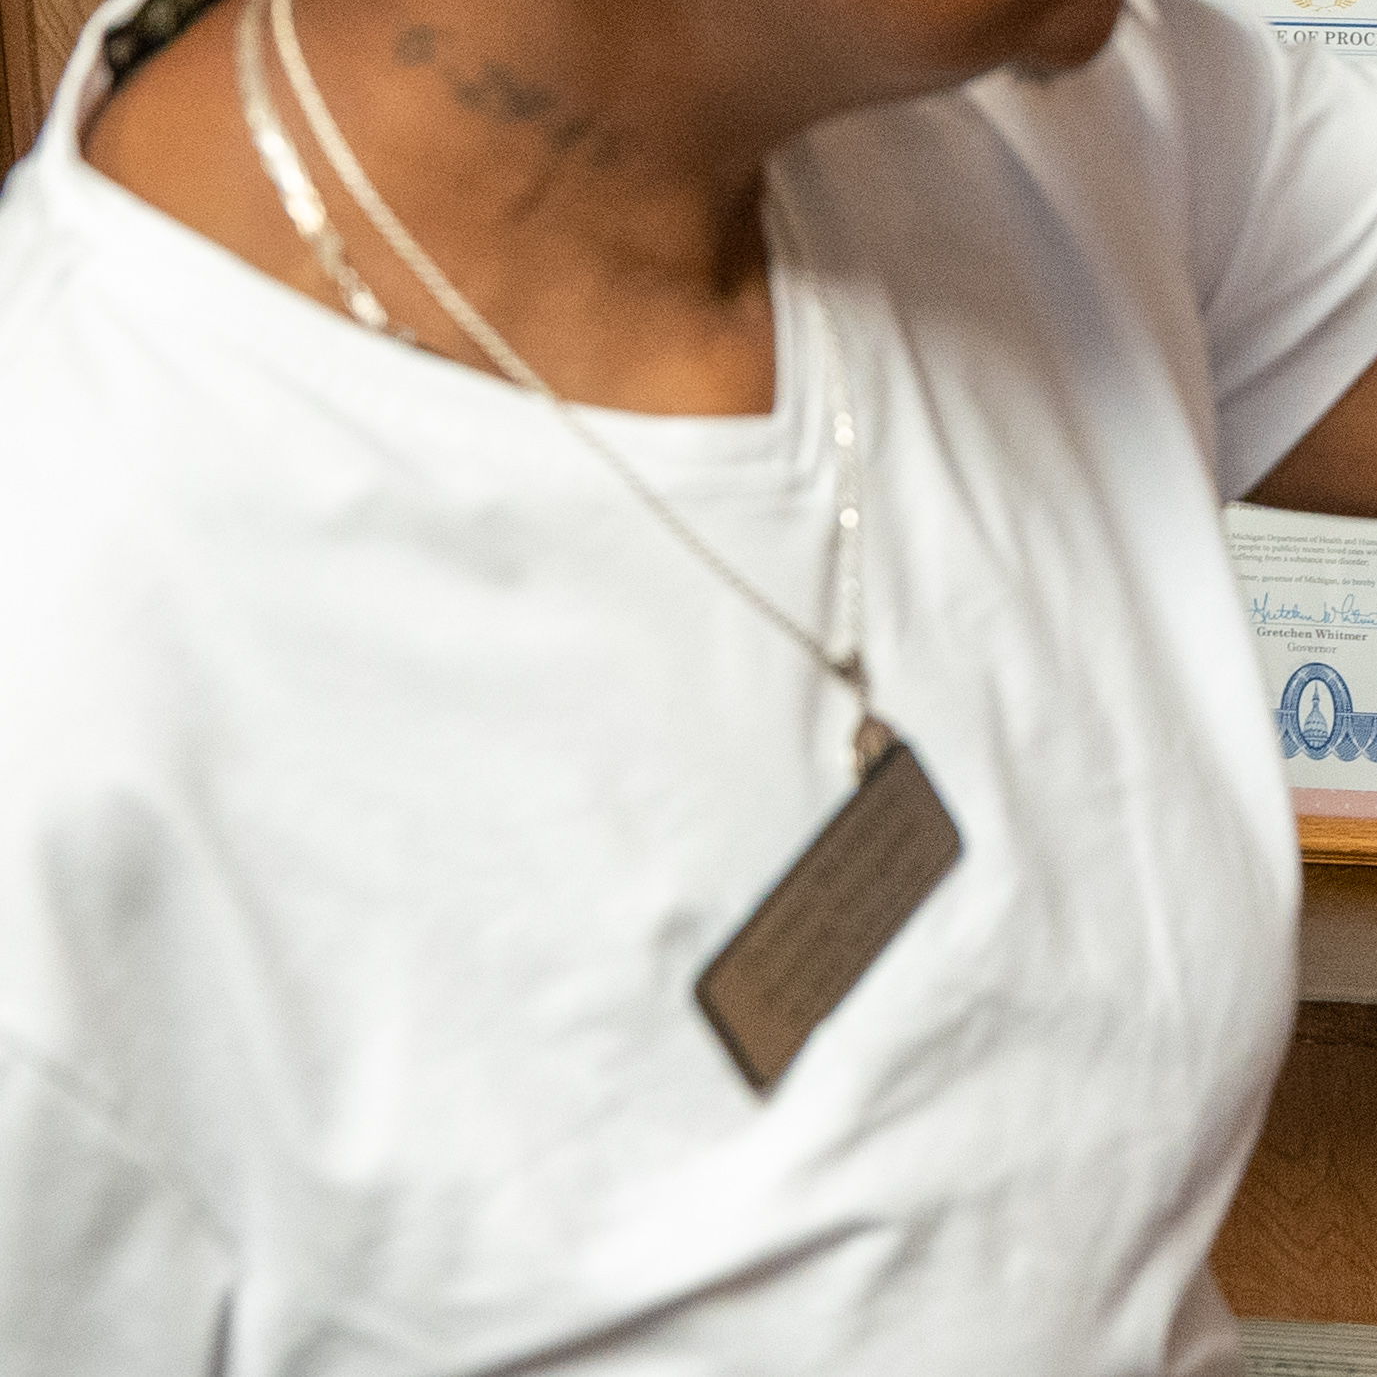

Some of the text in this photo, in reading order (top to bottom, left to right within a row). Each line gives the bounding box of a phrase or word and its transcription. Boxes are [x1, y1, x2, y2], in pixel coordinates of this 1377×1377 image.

[1293, 30, 1320, 46] OF
[1257, 626, 1368, 641] Gretchen Whitmer
